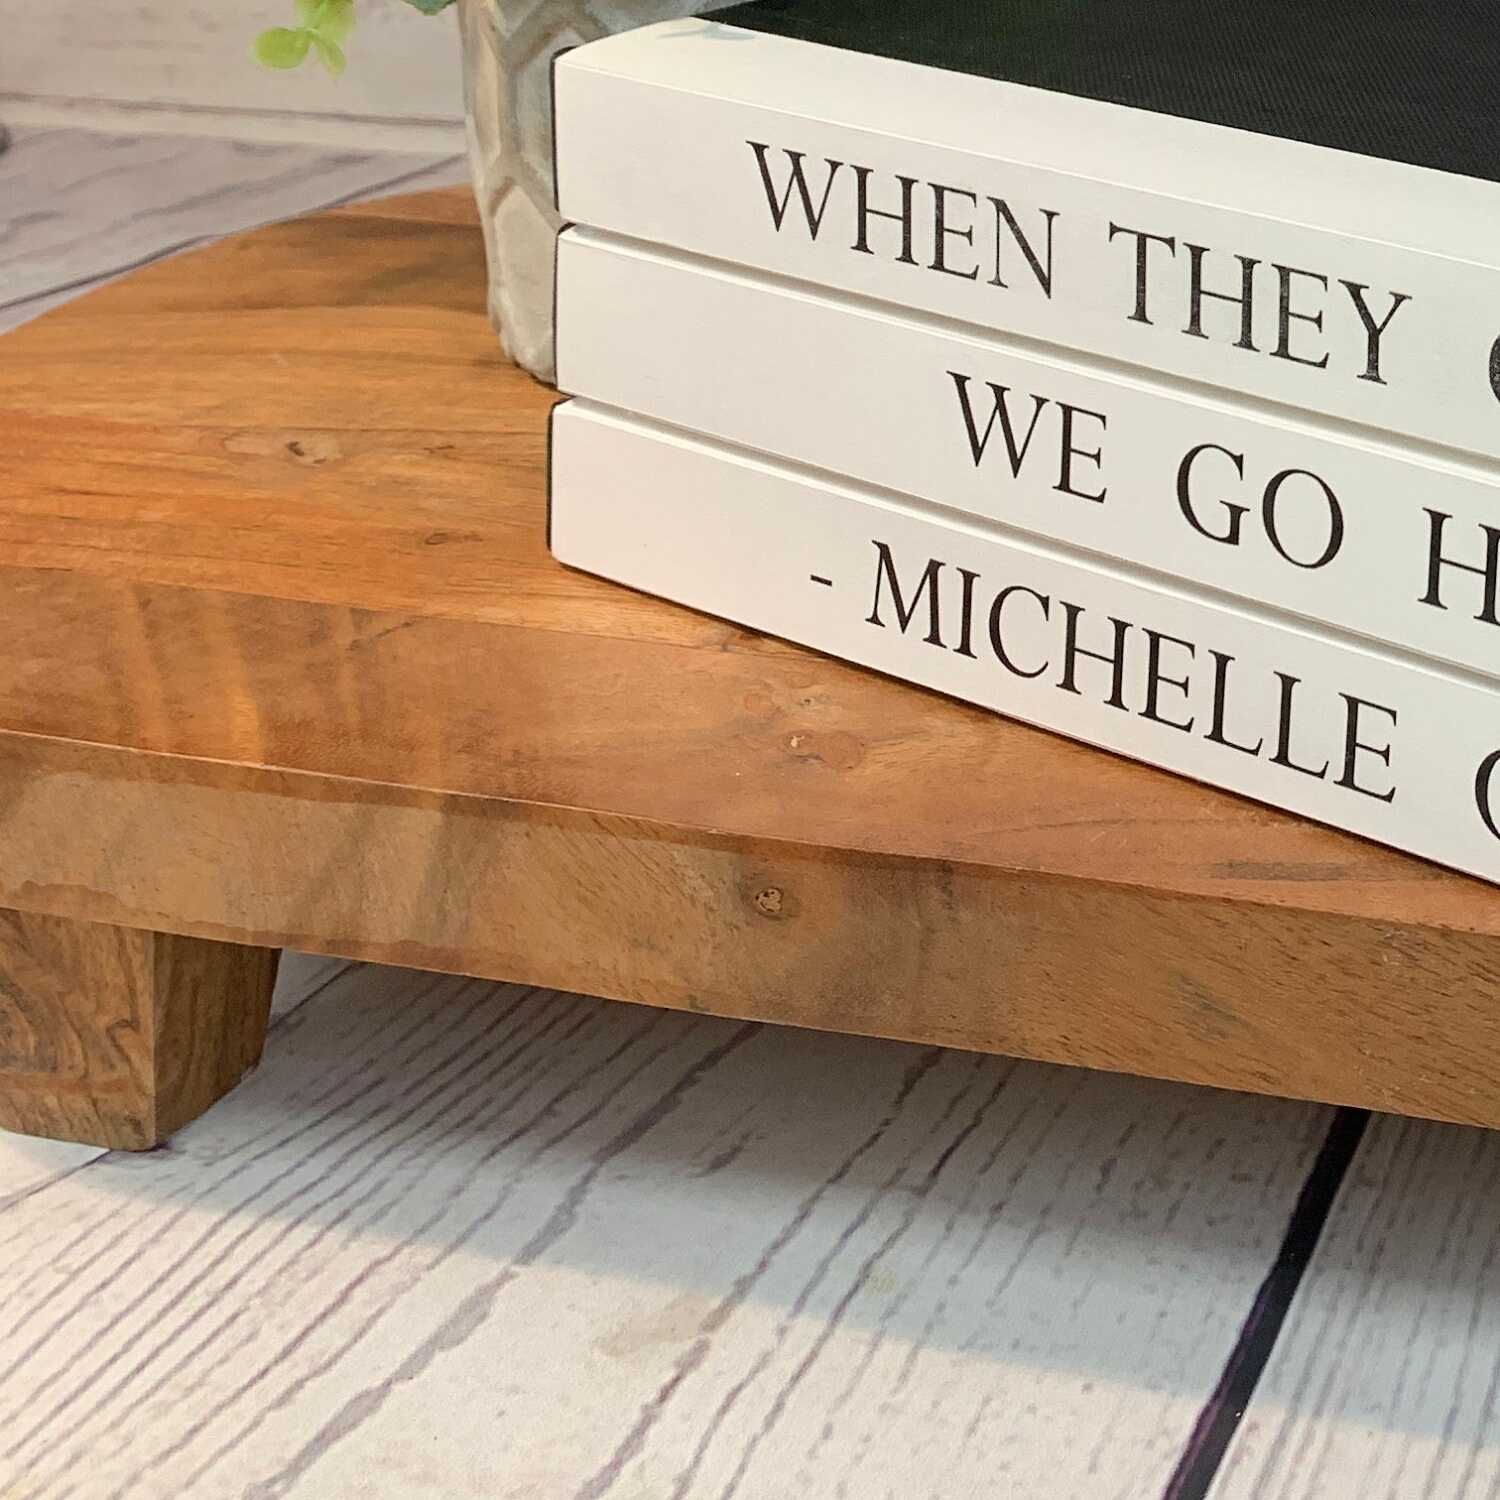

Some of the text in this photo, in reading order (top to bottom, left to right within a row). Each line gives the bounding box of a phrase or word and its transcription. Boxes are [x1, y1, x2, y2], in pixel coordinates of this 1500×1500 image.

[745, 140, 1061, 300] WHEN
[1108, 220, 1413, 387] THEY
[945, 369, 1108, 505] WE
[1176, 442, 1345, 570] GO
[809, 573, 834, 589] -
[864, 539, 1399, 804] MICHELLE
